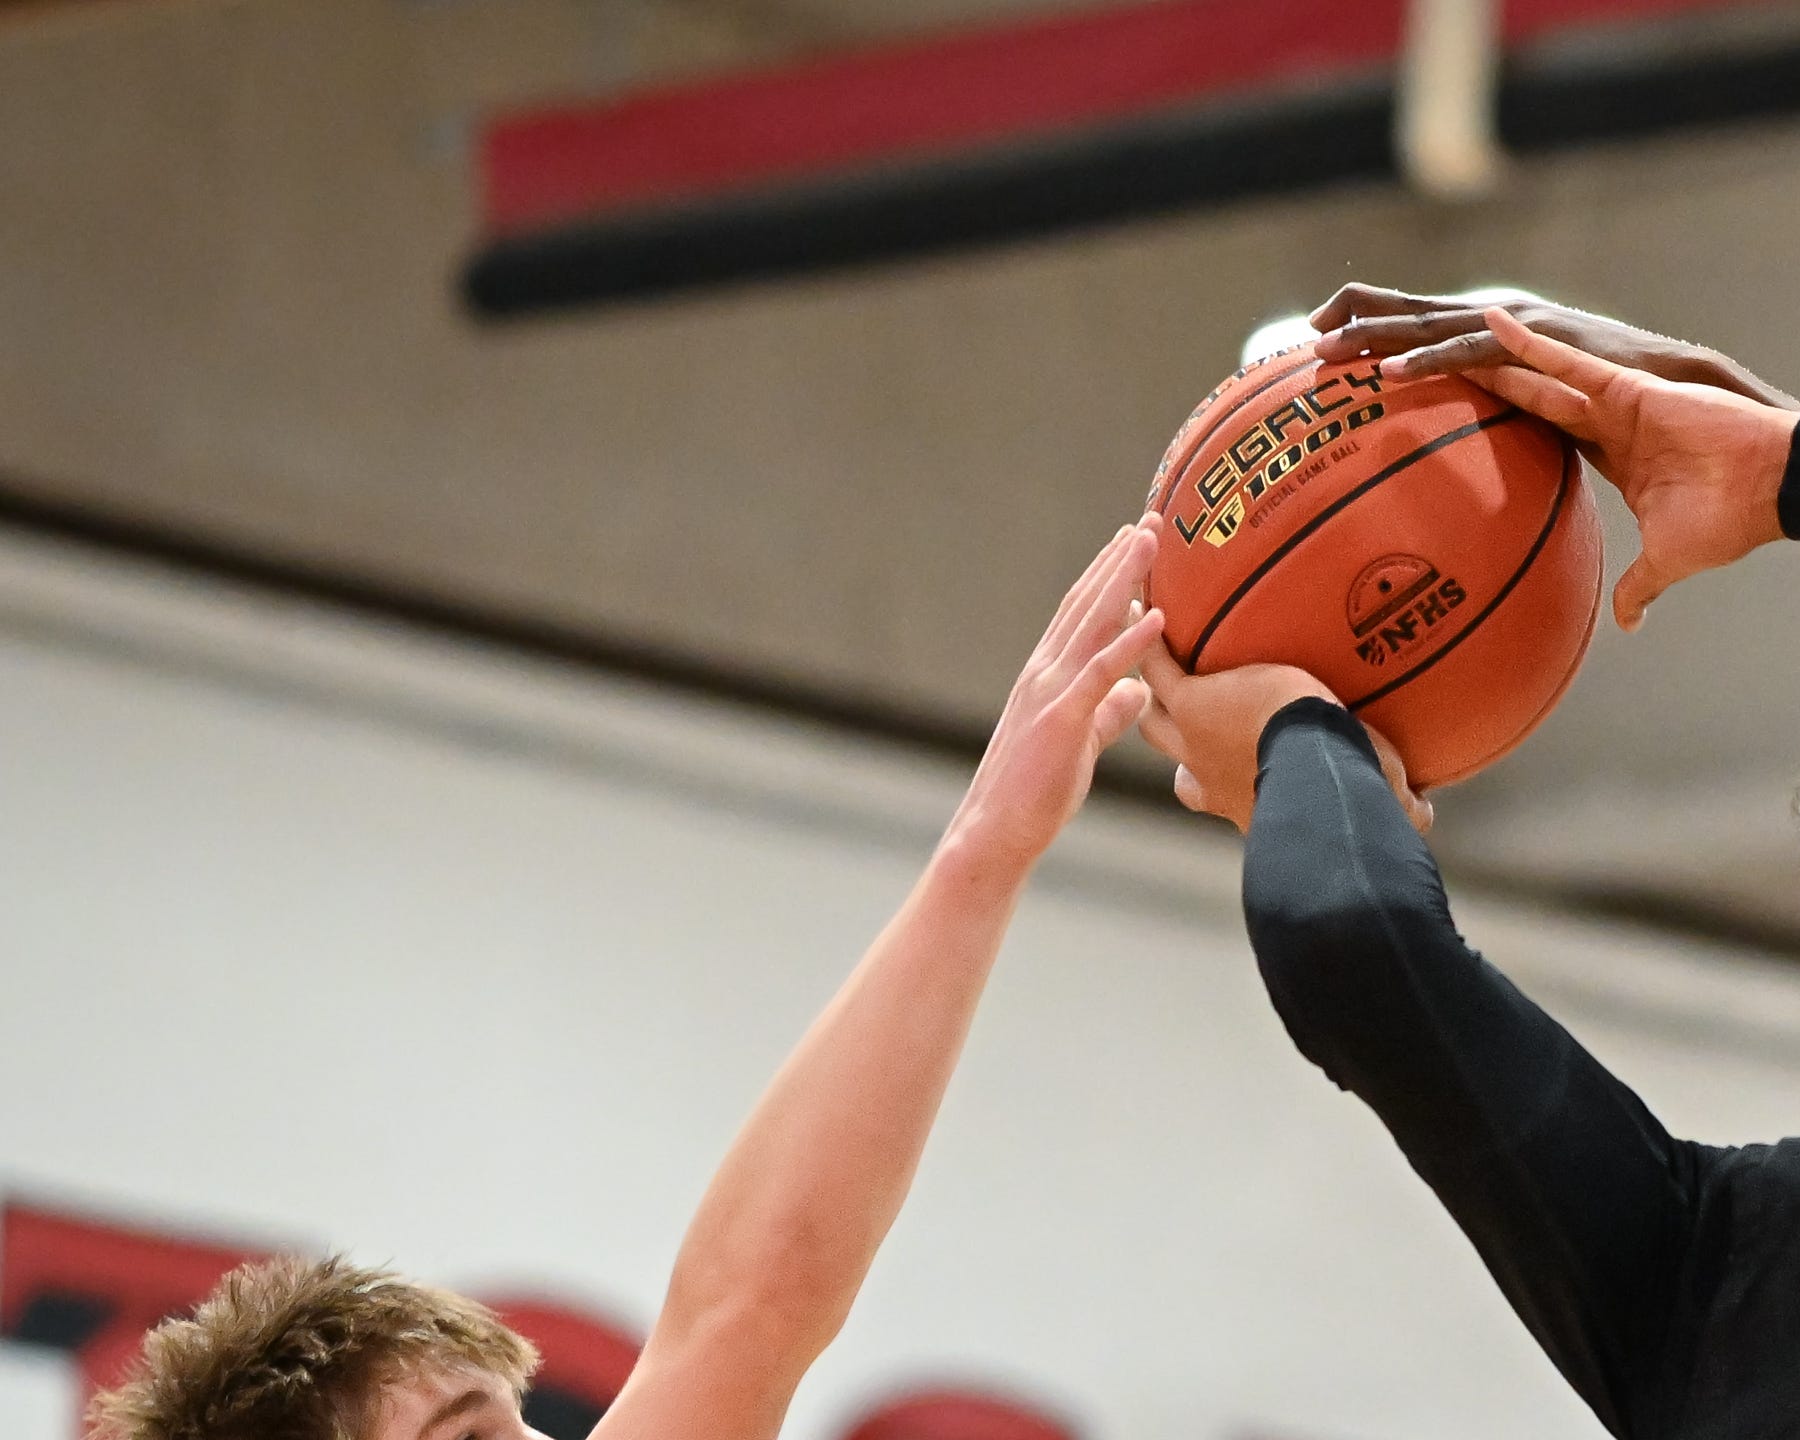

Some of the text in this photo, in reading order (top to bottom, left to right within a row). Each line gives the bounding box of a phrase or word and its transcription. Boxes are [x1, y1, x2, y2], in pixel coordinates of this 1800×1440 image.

[1172, 363, 1384, 549] LEGACY
[1205, 496, 1244, 543] TF
[1243, 402, 1385, 502] 1000
[1249, 441, 1361, 528] OFFICIAL GAME BALL
[1380, 578, 1467, 653] NFHS
